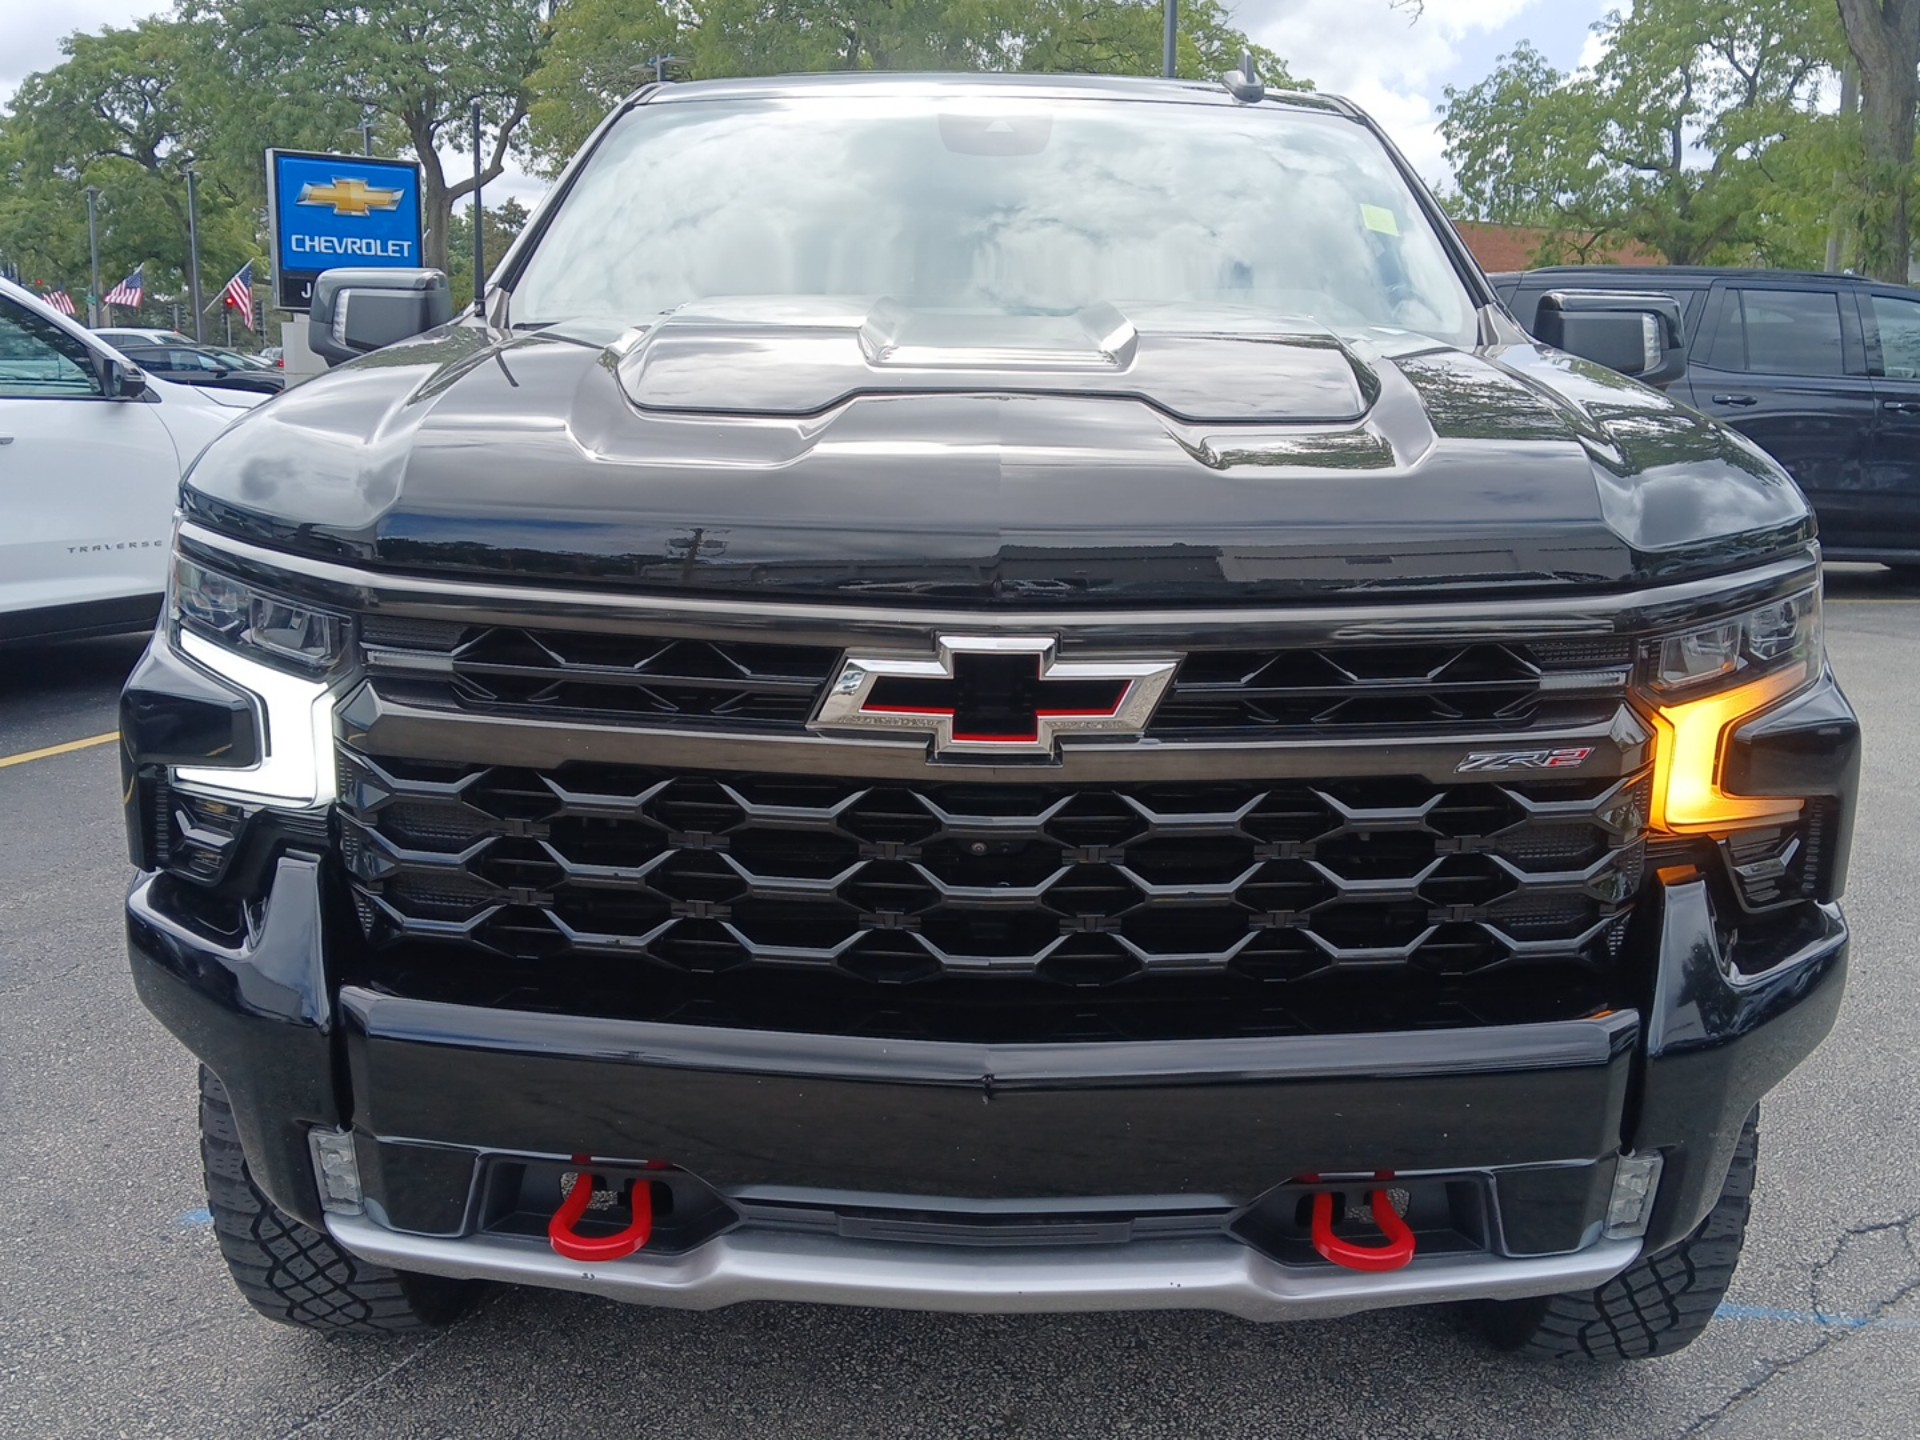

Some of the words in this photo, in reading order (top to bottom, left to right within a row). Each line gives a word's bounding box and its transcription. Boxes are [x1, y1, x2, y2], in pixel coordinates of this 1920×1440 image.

[291, 234, 412, 257] CHEVROLET
[67, 540, 163, 554] TRAVERSE
[1454, 747, 1595, 773] ZR2
